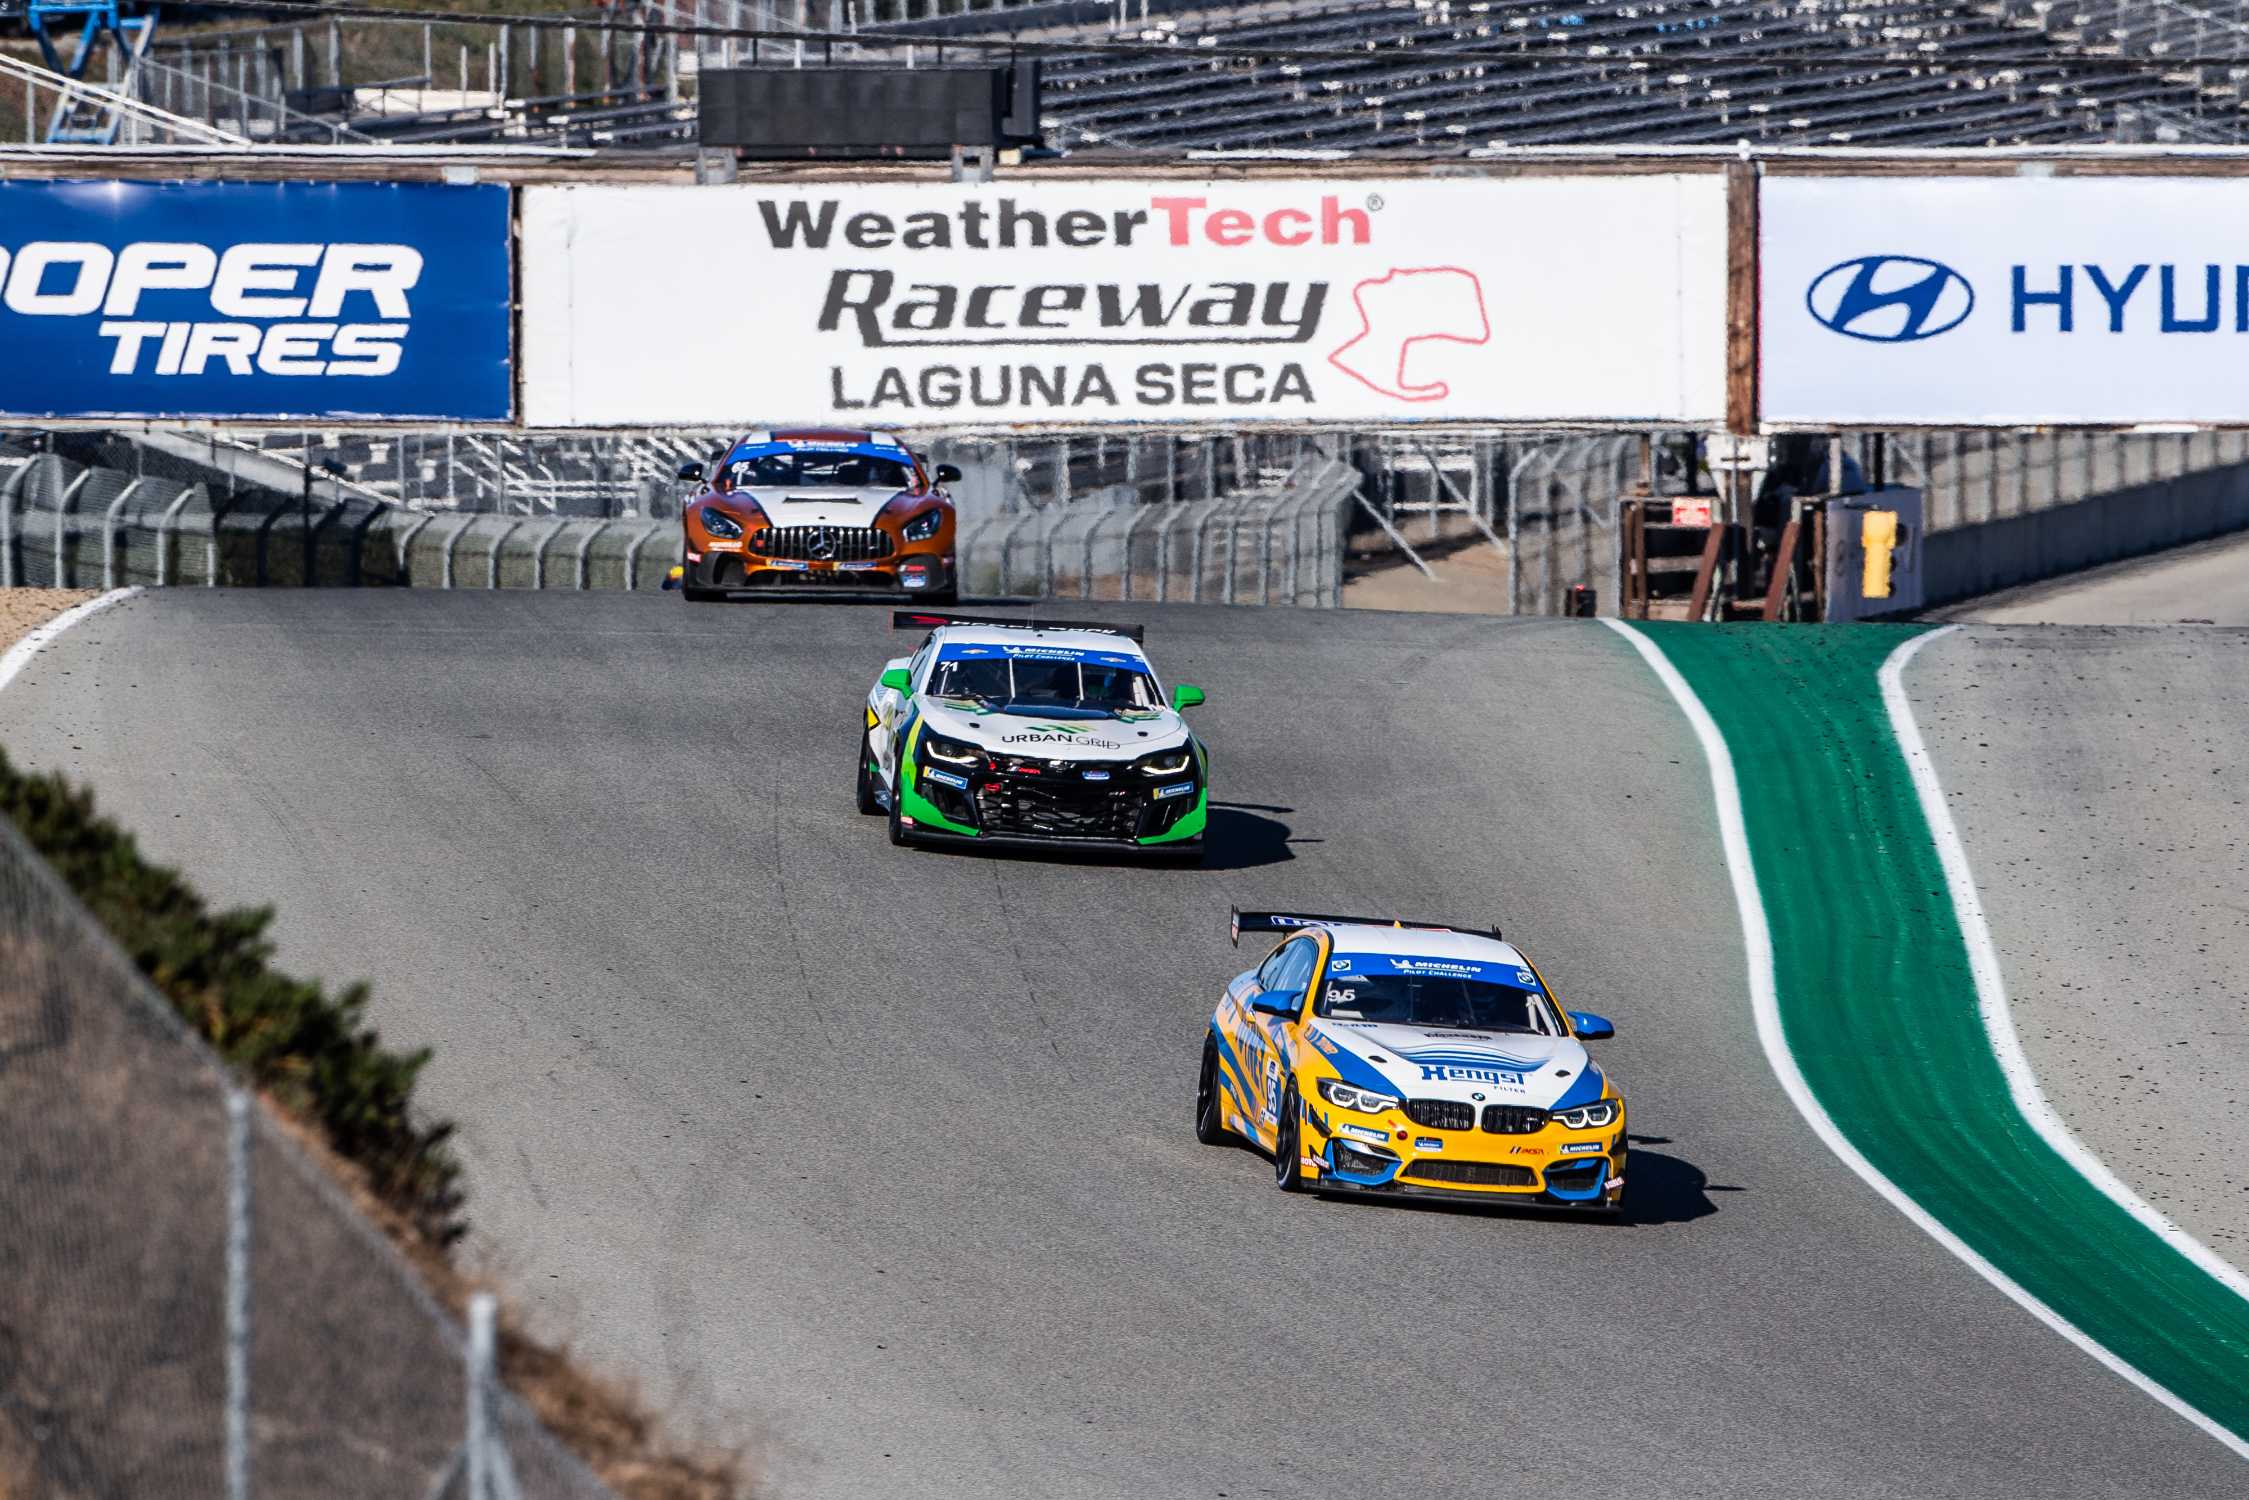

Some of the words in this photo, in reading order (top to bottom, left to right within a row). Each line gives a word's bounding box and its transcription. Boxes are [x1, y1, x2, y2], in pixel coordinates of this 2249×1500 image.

[0, 241, 424, 319] OPER
[2010, 263, 2249, 333] HYU
[818, 268, 1328, 347] Raceway
[99, 320, 410, 377] TIRES
[831, 363, 1119, 410] LAGUNA
[1135, 362, 1316, 406] SECA
[940, 661, 959, 673] 71
[1414, 961, 1483, 974] MICHELIN
[1328, 988, 1356, 1003] 95
